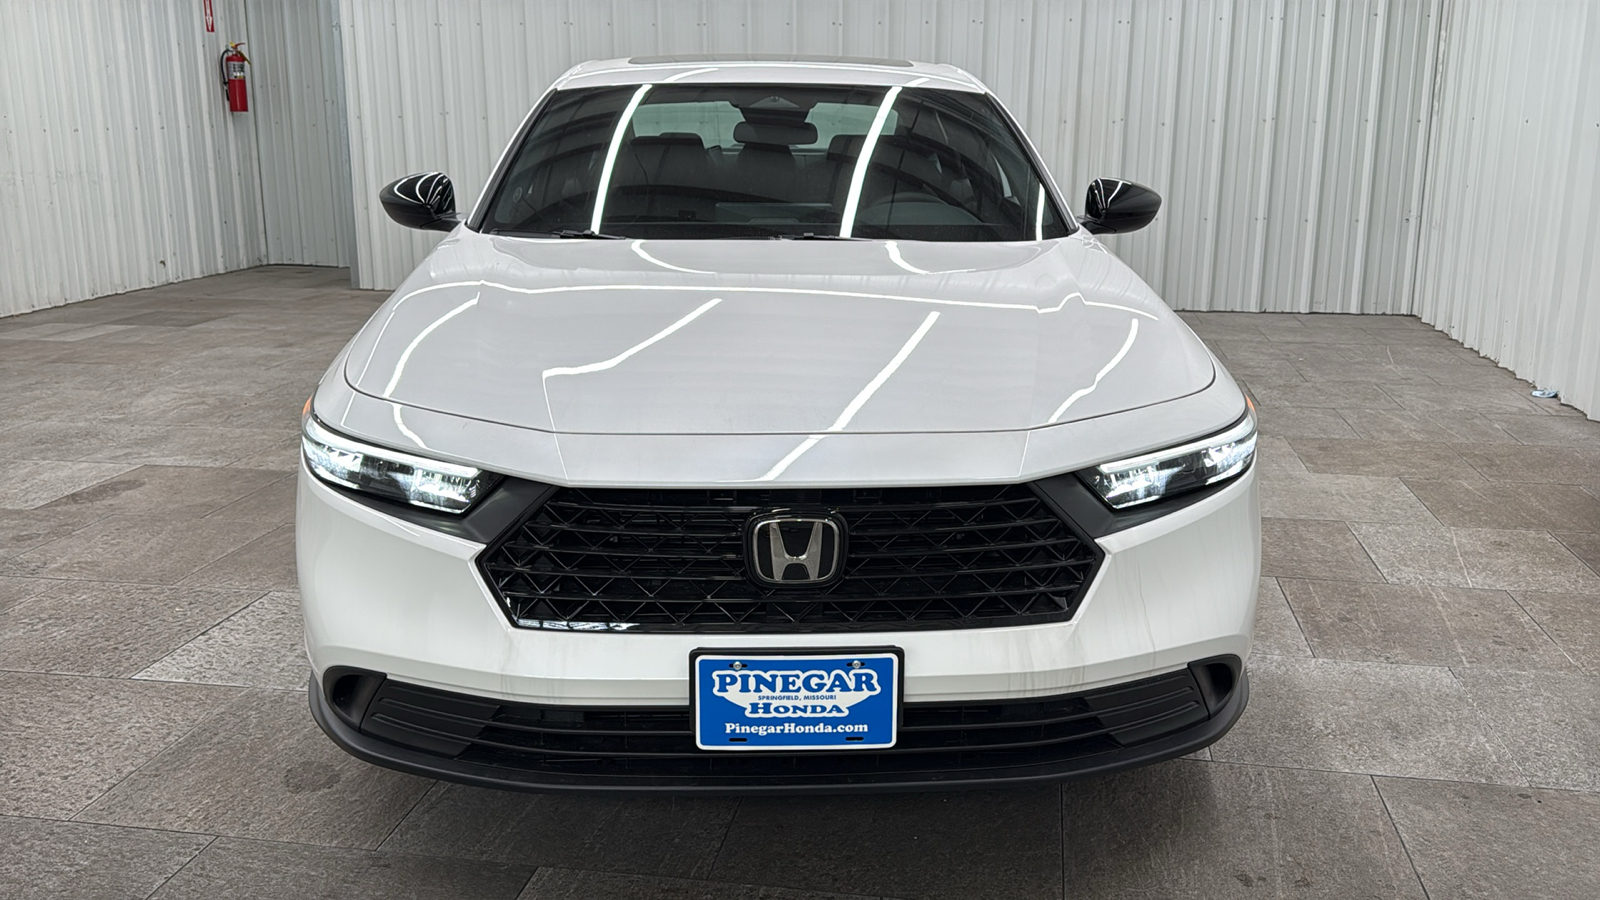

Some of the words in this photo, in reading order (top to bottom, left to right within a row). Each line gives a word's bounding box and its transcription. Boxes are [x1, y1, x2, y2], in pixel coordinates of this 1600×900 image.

[716, 672, 878, 693] PINEGAR
[749, 702, 845, 715] HONDA
[724, 722, 869, 736] PinegarHonda.com
